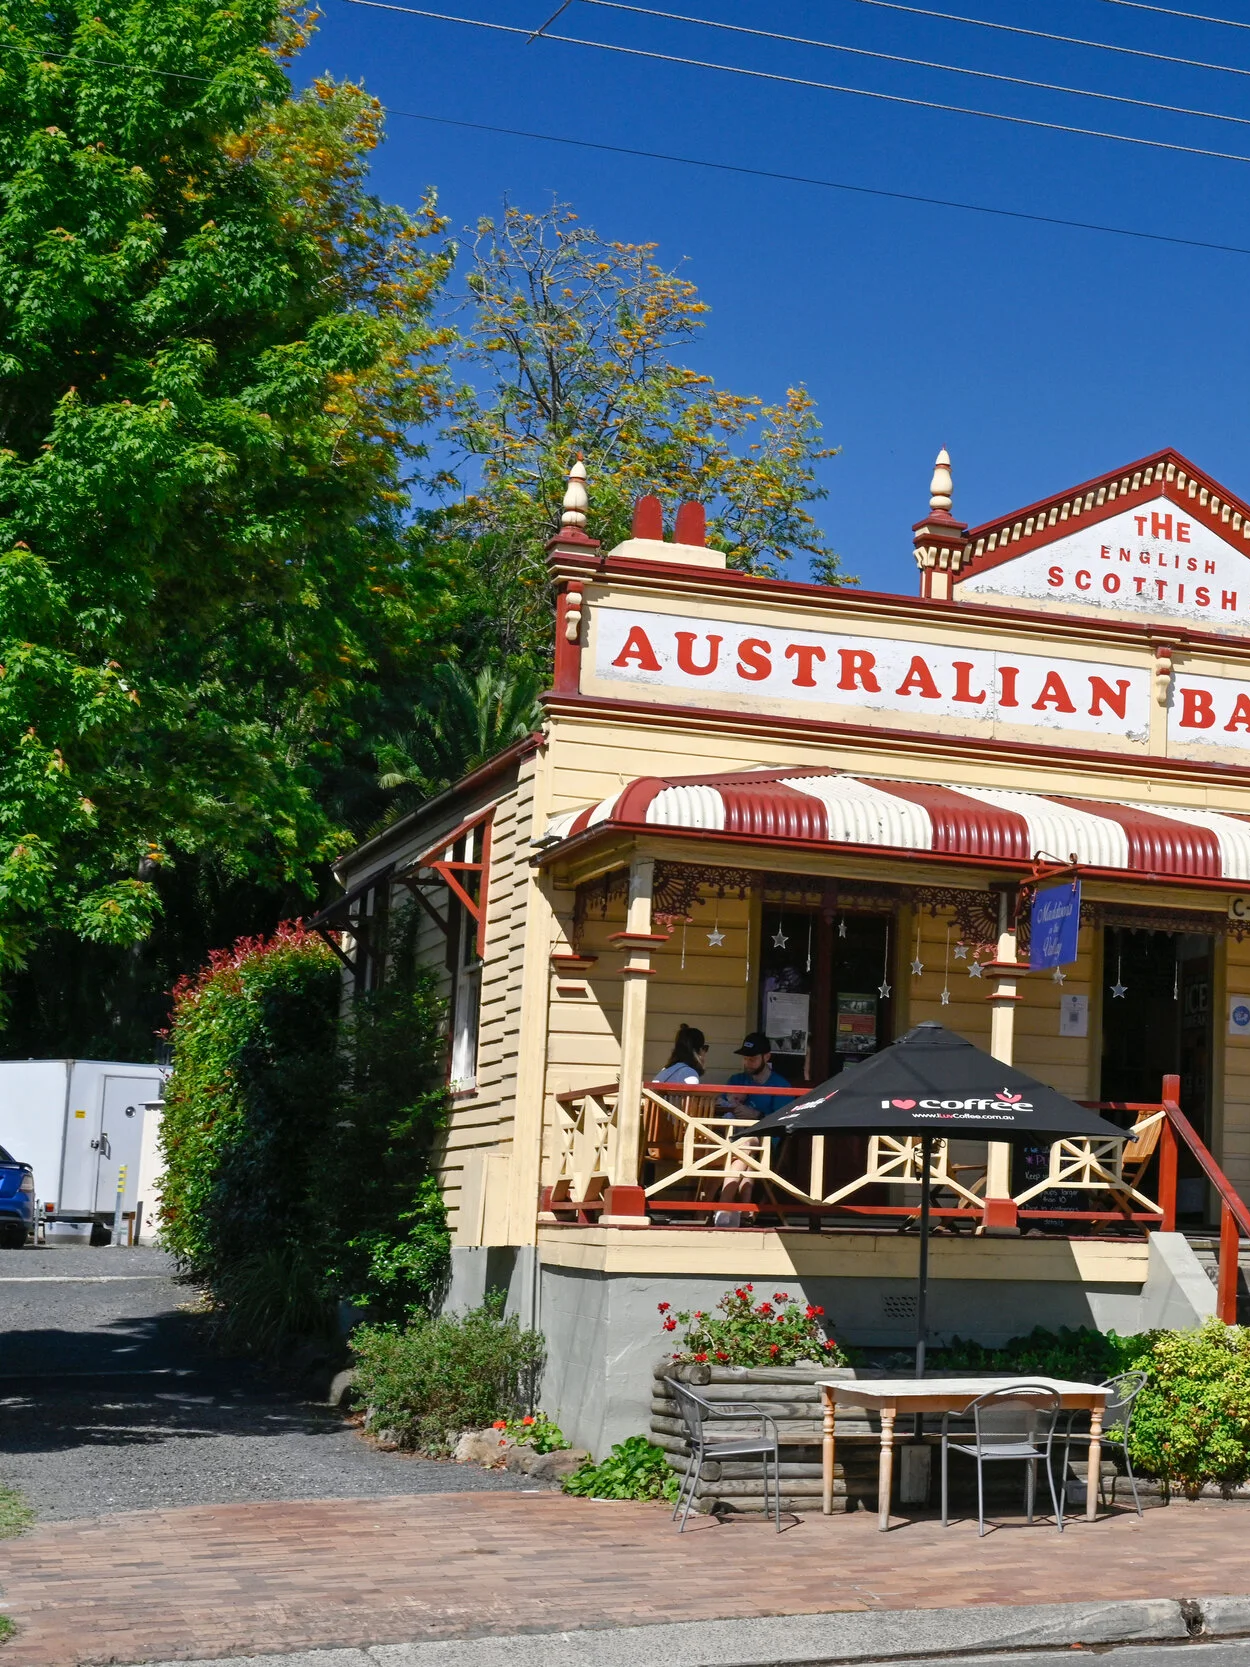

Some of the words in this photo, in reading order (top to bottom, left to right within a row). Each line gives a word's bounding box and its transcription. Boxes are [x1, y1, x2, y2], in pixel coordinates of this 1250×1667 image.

[1134, 512, 1191, 543] THE
[1100, 545, 1215, 574] ENGLISH
[1048, 566, 1237, 611] SCOTTISH
[612, 626, 1131, 719] AUSTRALIAN
[881, 1100, 890, 1109] I
[1025, 1171, 1040, 1181] Keep
